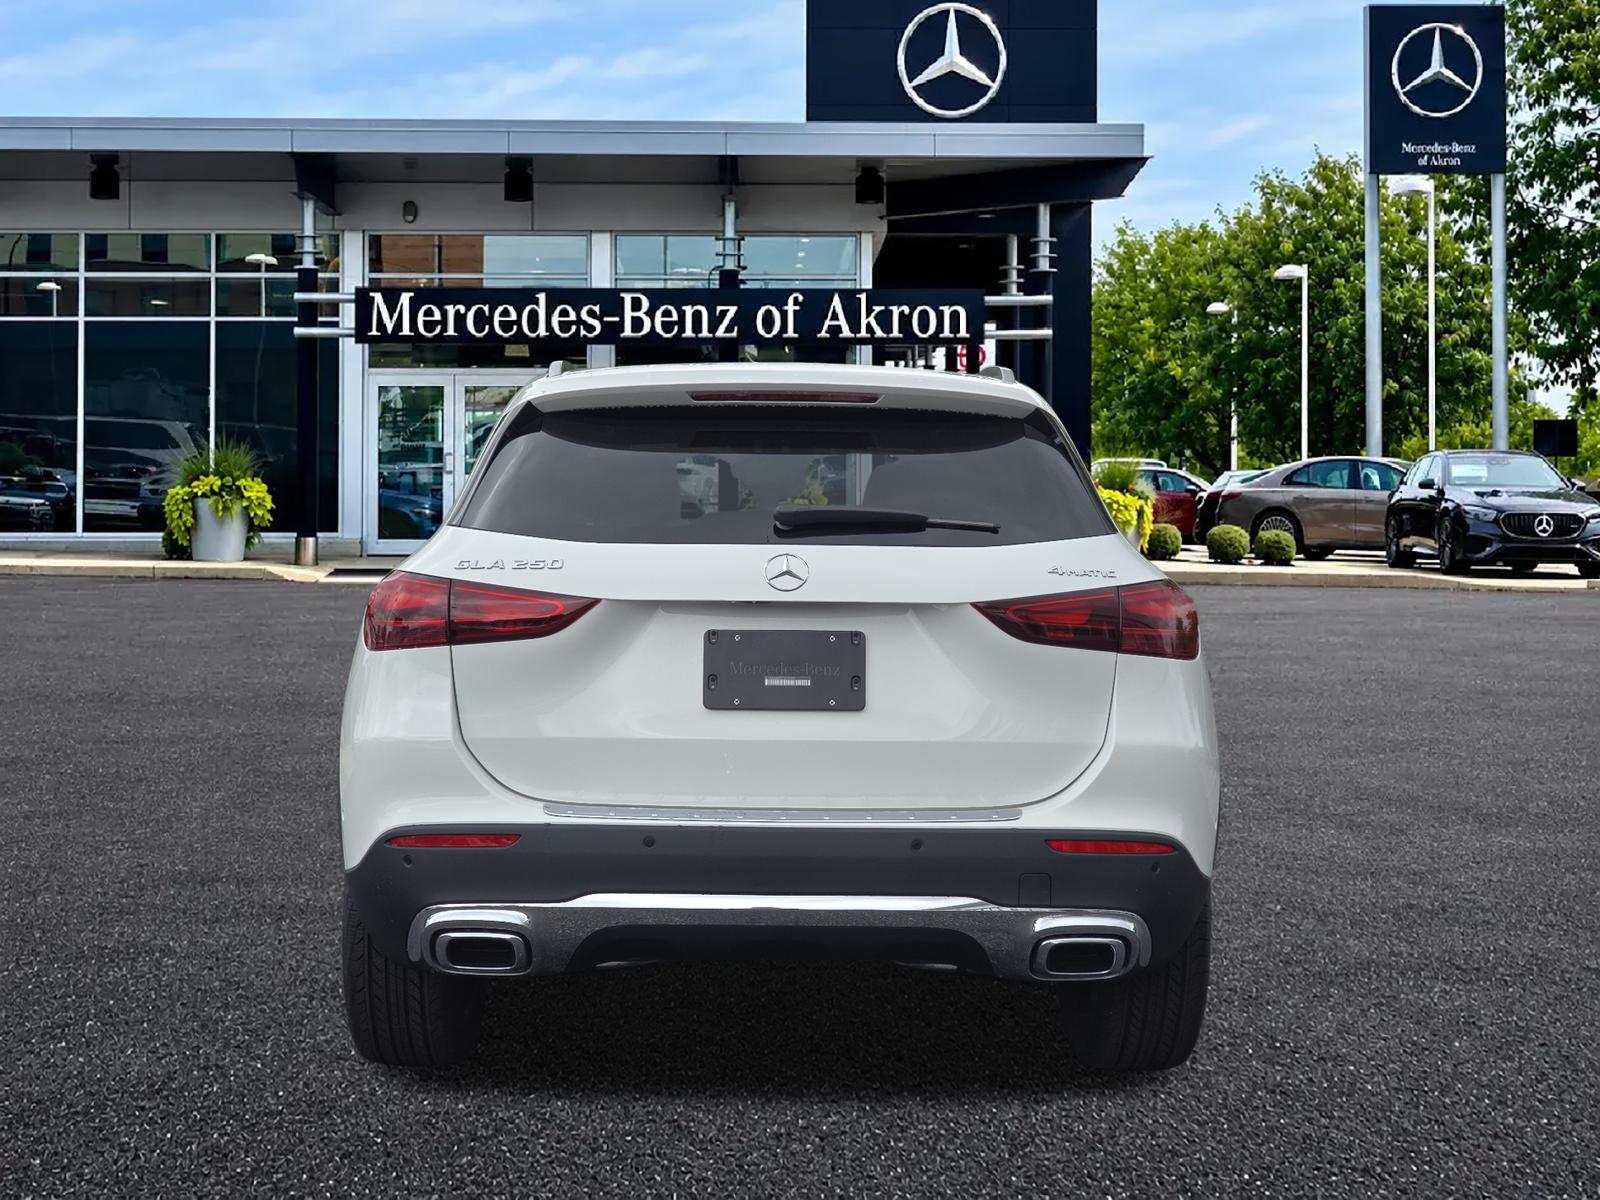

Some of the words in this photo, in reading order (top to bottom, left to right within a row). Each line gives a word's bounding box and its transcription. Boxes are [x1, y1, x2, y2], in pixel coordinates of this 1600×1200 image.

[1401, 141, 1476, 154] Mercedes-Benz
[1417, 154, 1428, 166] of
[1430, 154, 1461, 166] Akron
[367, 291, 739, 338] Mercedes-Benz
[756, 291, 804, 338] of
[818, 292, 970, 338] Akron
[454, 559, 505, 571] GLA
[511, 559, 565, 571] 250
[1047, 565, 1117, 578] 4MATIC
[729, 661, 841, 677] Mercedes-Benz
